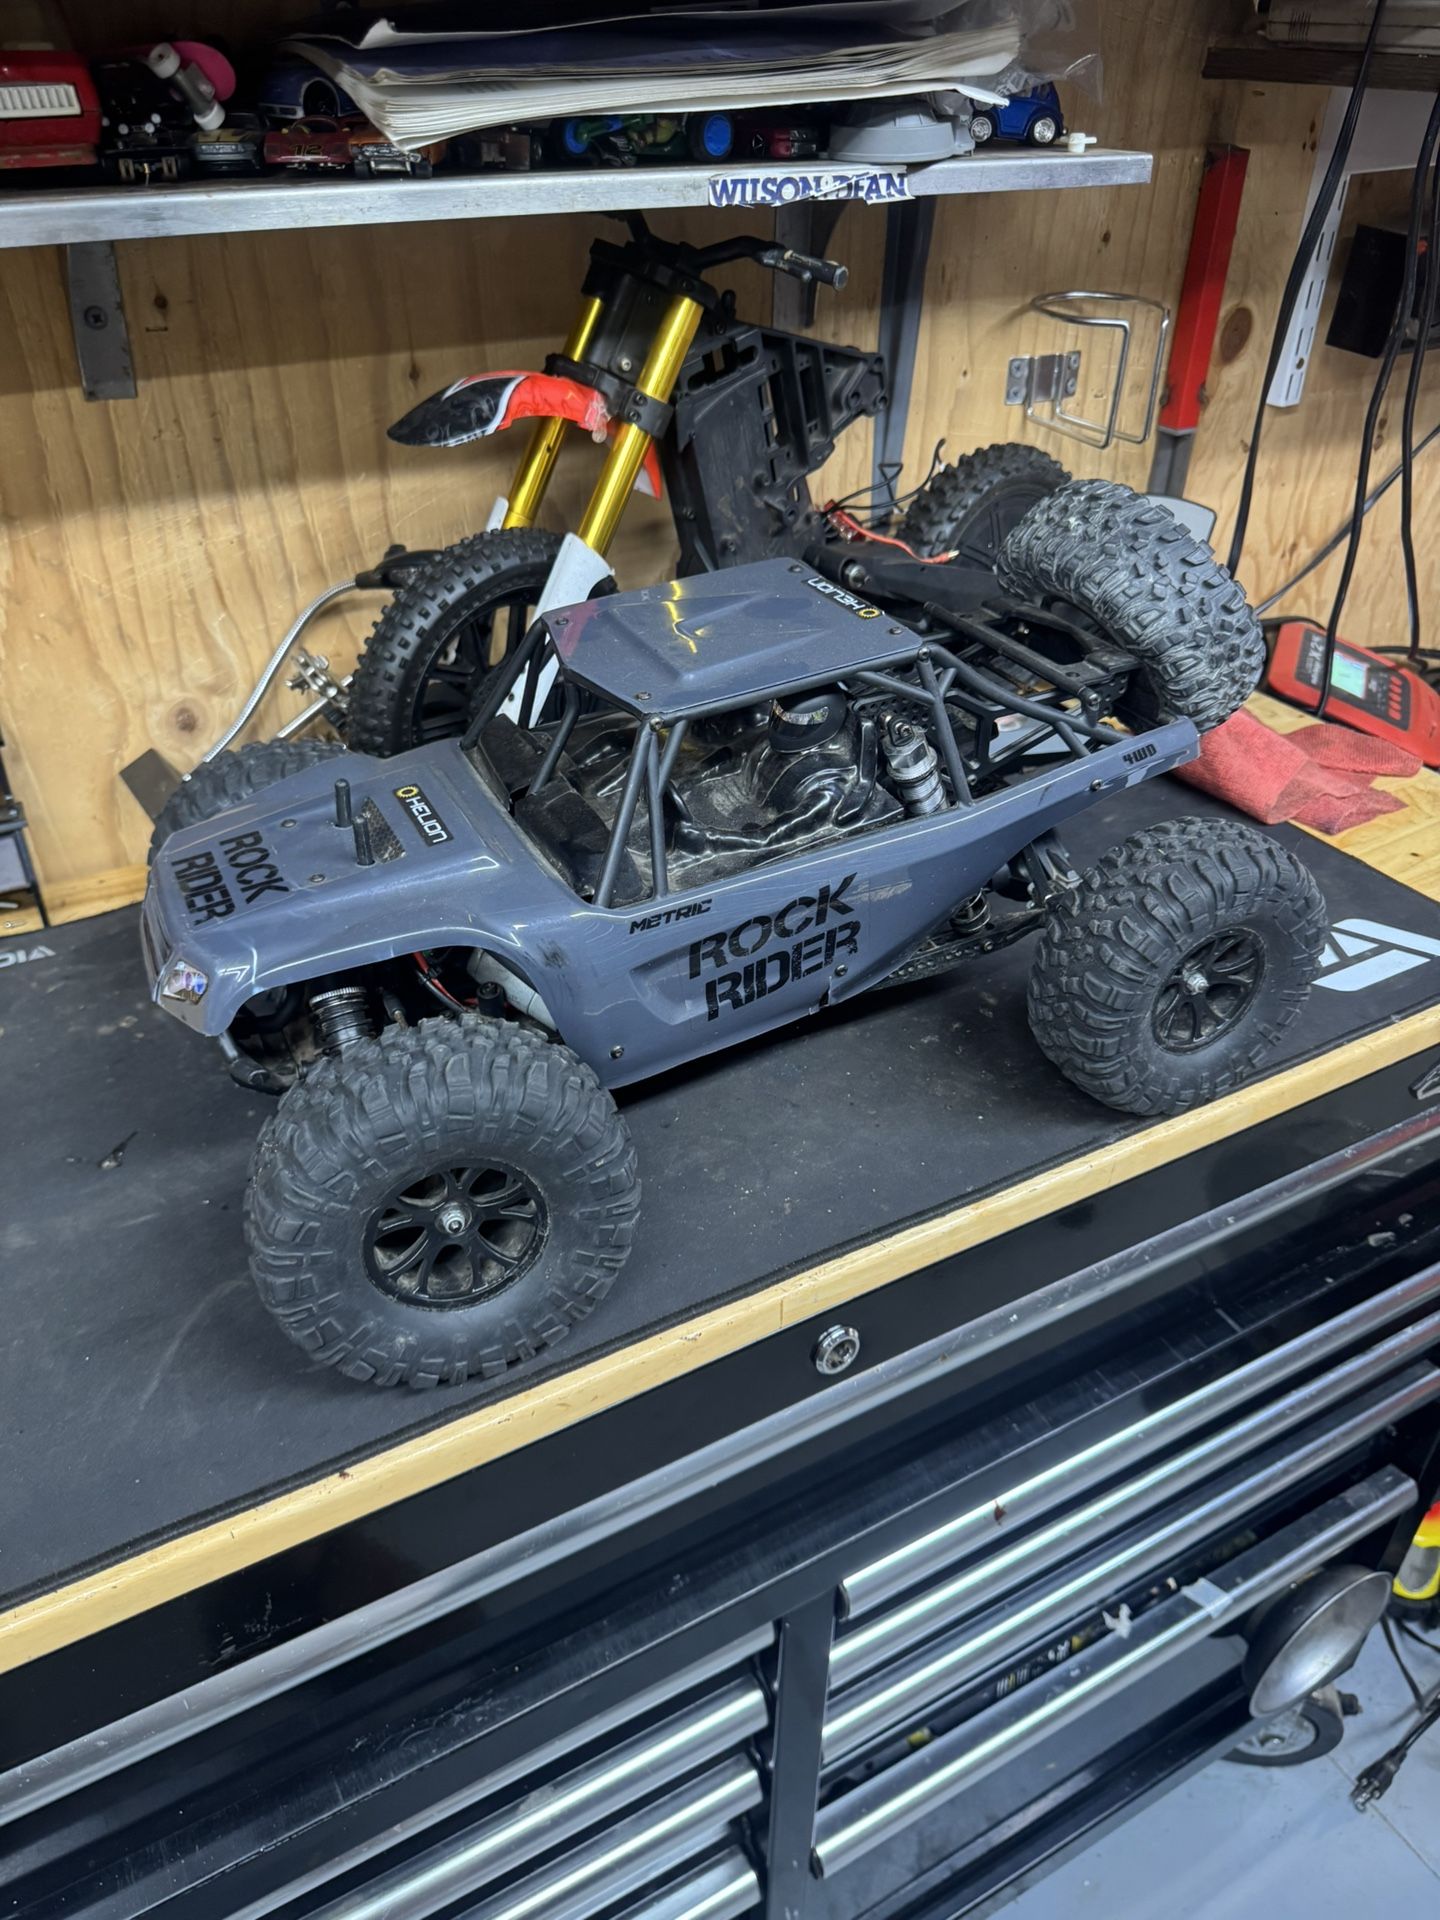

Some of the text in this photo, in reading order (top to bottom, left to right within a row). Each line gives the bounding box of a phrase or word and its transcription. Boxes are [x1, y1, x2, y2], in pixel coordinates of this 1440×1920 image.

[807, 577, 866, 610] HELION
[1122, 744, 1157, 764] 4WD
[405, 796, 448, 843] HELION
[171, 851, 236, 926] RIDER
[219, 831, 290, 904] ROCK
[629, 899, 713, 934] METRIC
[688, 872, 858, 980] ROCK
[705, 920, 861, 1021] RIDER
